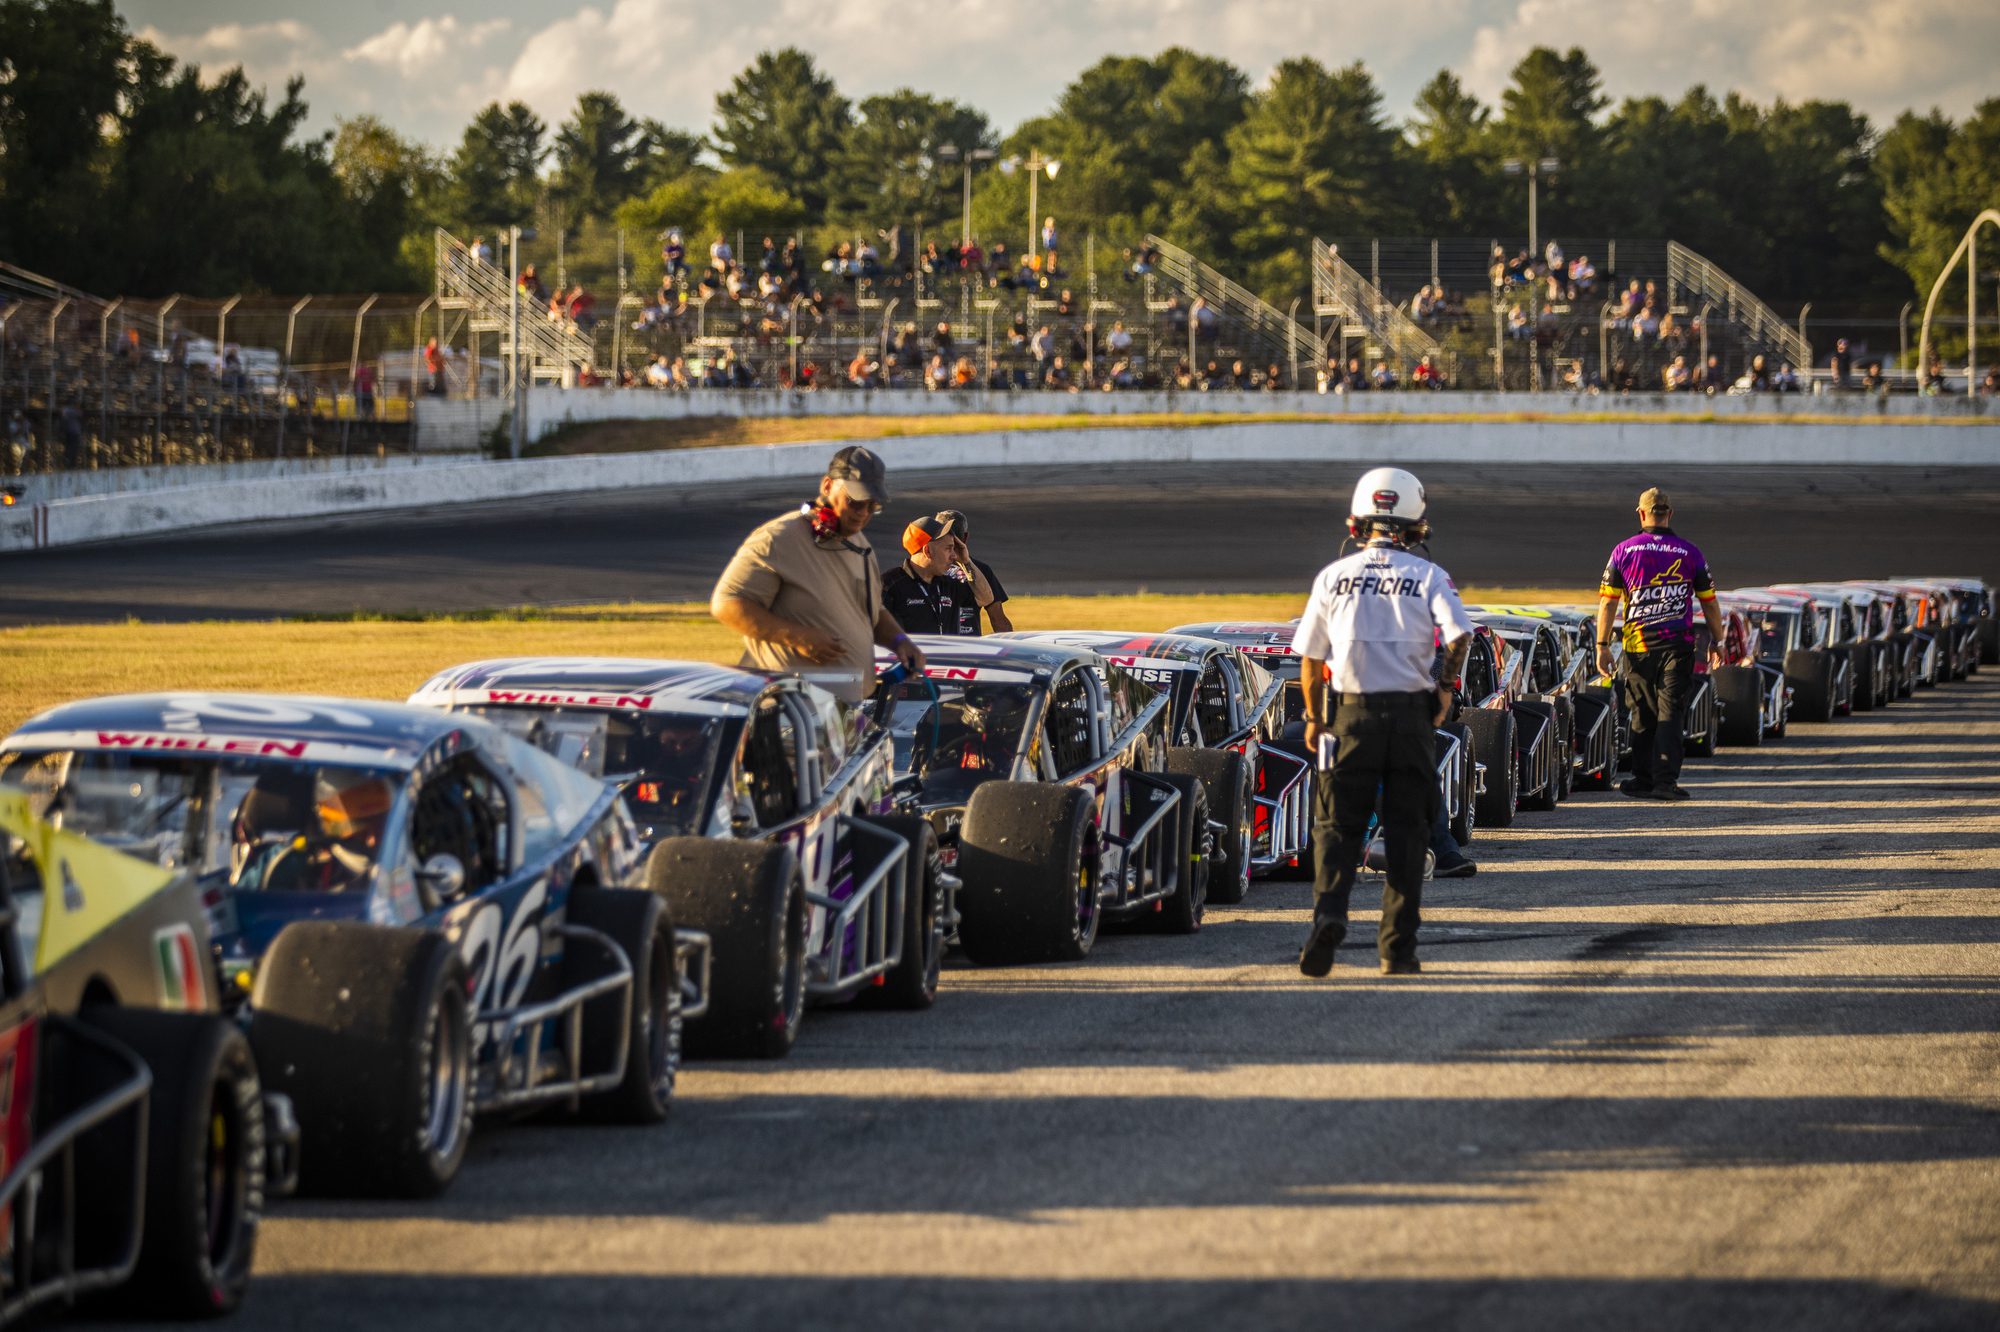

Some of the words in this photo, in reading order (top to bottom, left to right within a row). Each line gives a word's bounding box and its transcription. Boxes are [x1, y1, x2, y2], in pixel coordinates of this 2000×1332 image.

[1336, 576, 1422, 598] OFFICIAL
[1626, 602, 1672, 622] JESUS
[1091, 666, 1173, 683] RUSE
[488, 690, 654, 710] WHELEN
[97, 731, 309, 758] WHELEN
